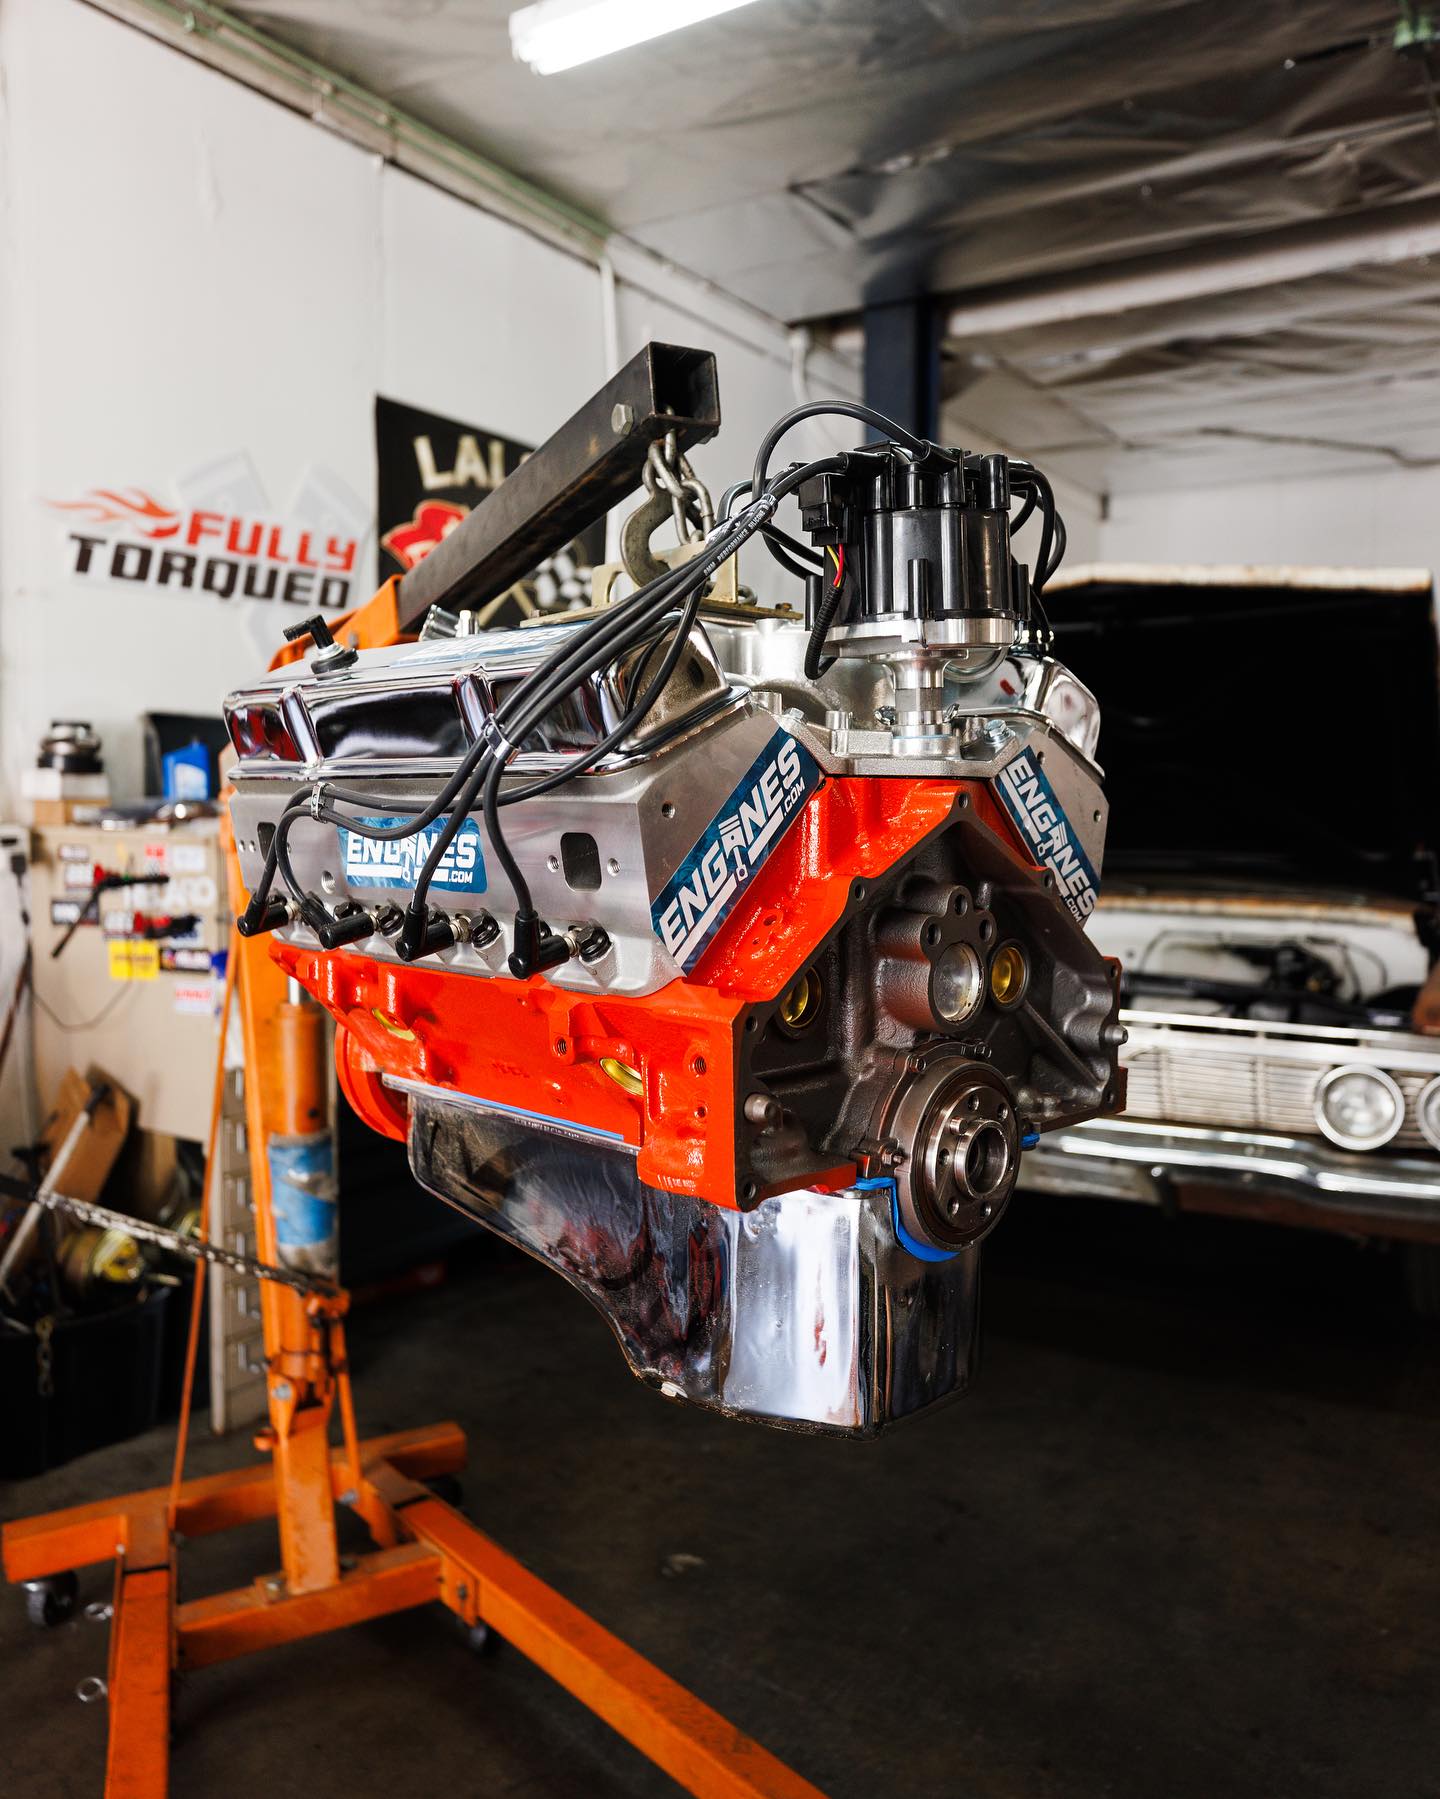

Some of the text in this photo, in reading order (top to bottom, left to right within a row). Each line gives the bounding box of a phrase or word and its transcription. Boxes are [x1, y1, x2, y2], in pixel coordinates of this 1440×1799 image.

[186, 509, 357, 572] FULLY
[717, 528, 749, 562] PERFORMANCE
[70, 533, 350, 609] TORQUED
[783, 776, 806, 816] .COM
[659, 738, 801, 956] ENGINES
[1006, 755, 1098, 916] ENGINES
[448, 870, 474, 883] .COM
[1065, 897, 1083, 922] .COM
